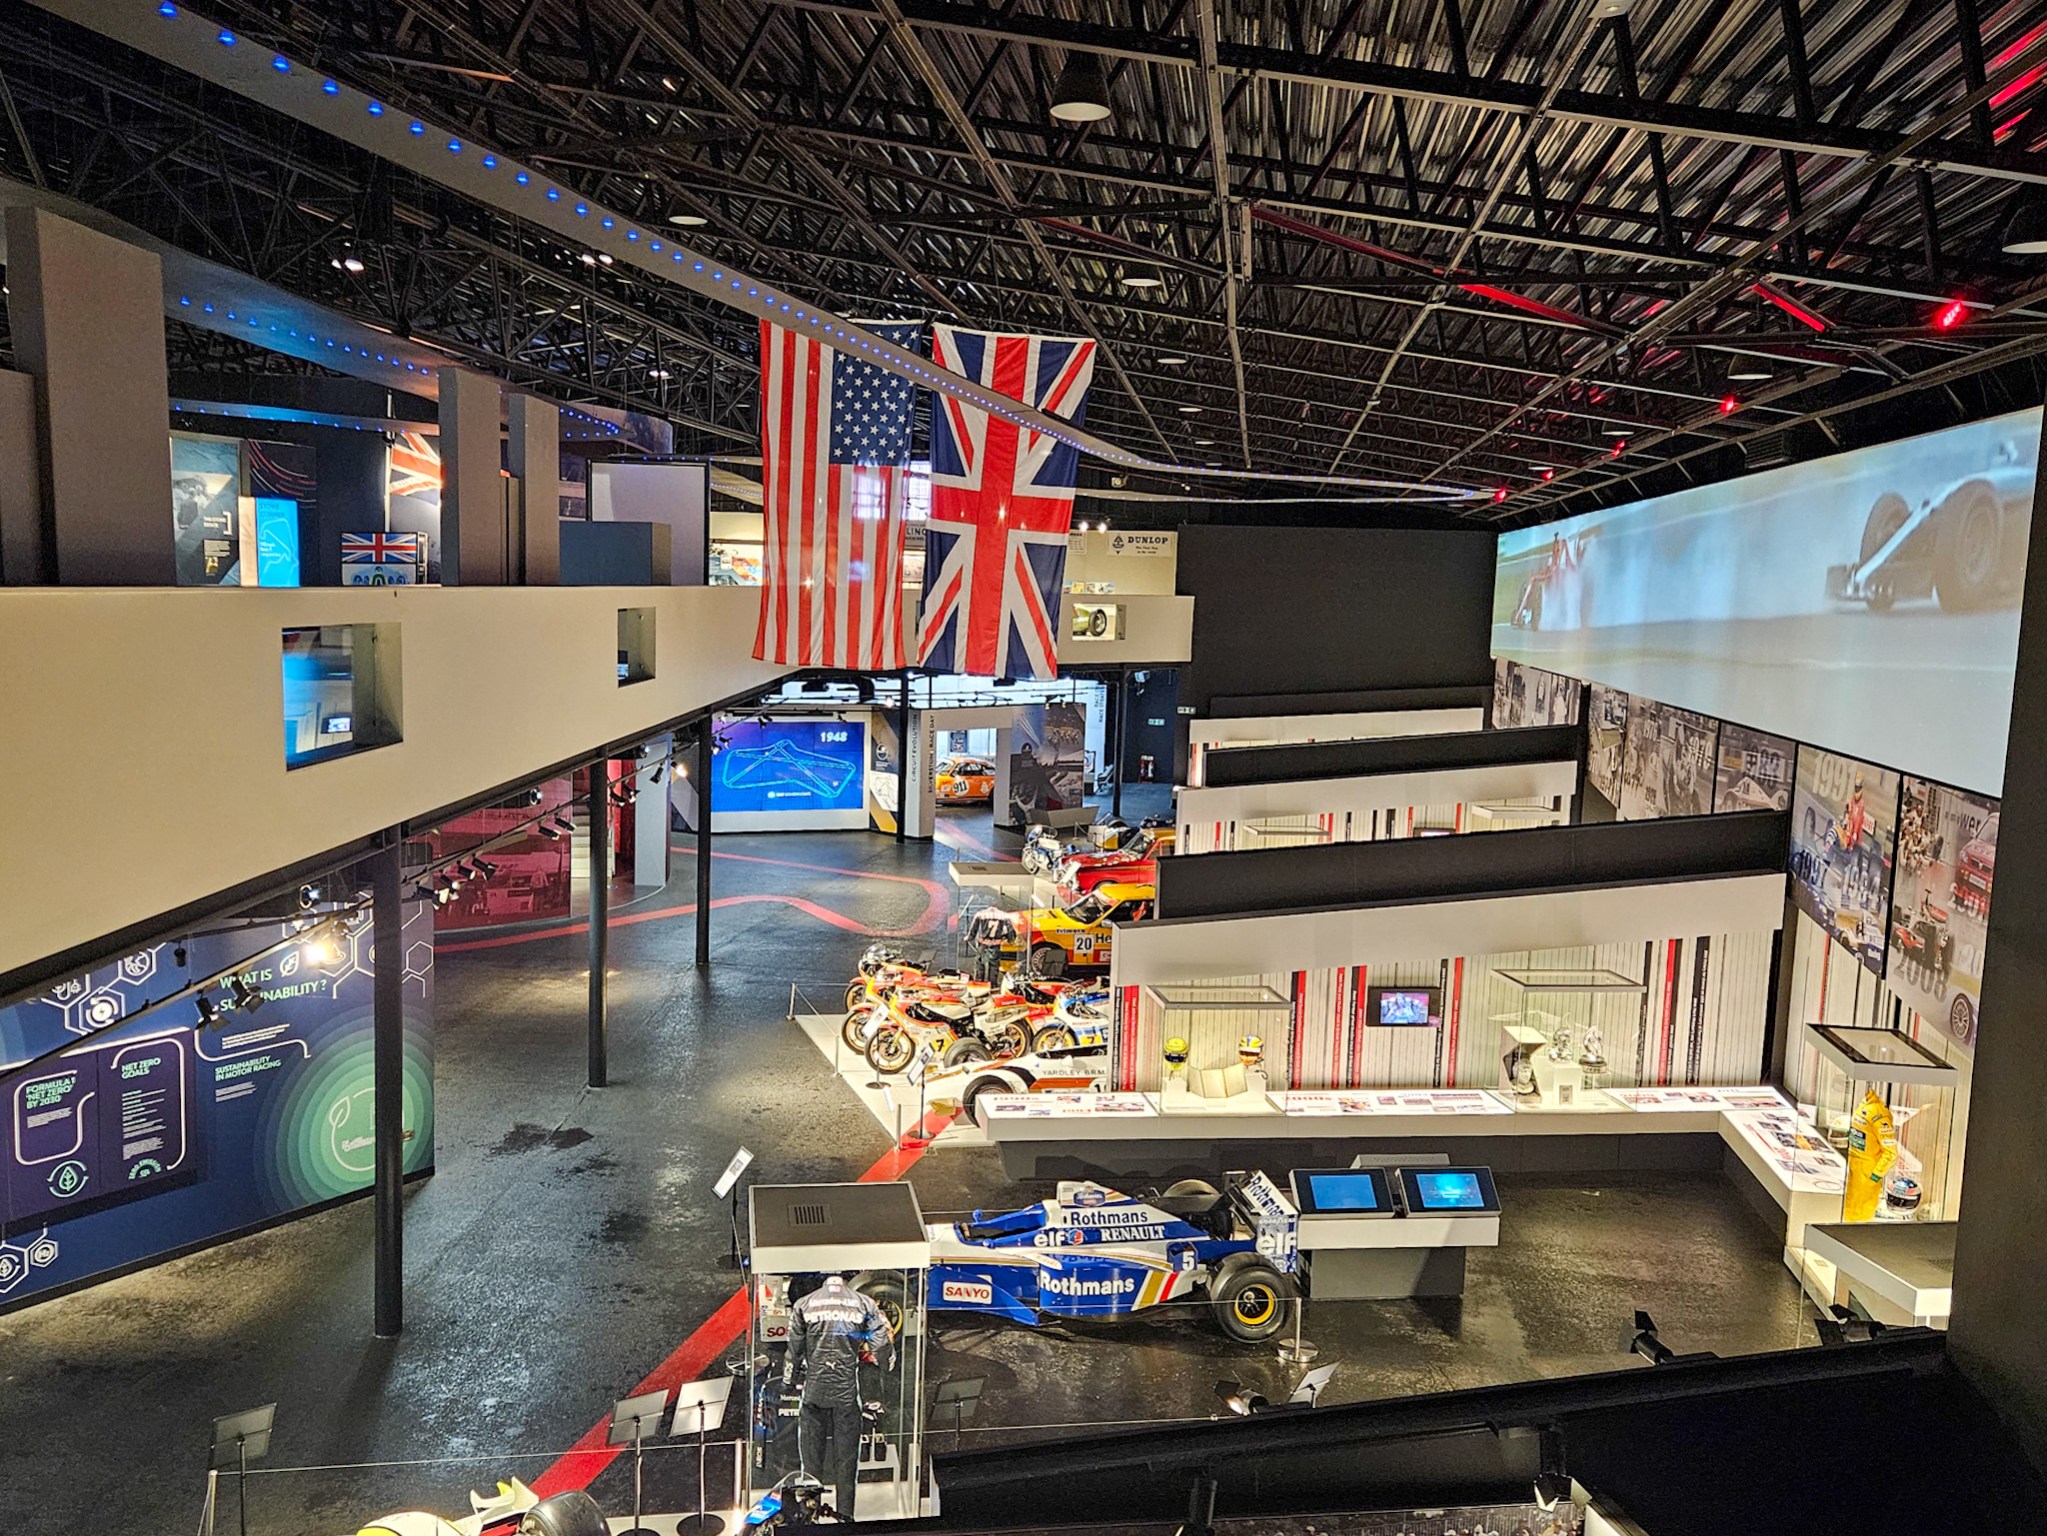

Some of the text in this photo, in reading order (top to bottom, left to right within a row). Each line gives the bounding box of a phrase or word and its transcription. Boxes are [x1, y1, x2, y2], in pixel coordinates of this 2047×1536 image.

[1128, 536, 1168, 545] DUNLOP
[820, 731, 848, 742] 1948
[953, 781, 968, 793] 911
[1812, 752, 1857, 806] 1991
[988, 920, 999, 938] 7
[1076, 938, 1092, 950] 20
[220, 969, 273, 989] WAT IS
[1894, 949, 1948, 1003] 2008
[220, 981, 319, 1012] SUNABILITY
[936, 1038, 945, 1052] 7
[121, 1057, 162, 1073] NET ZERO
[121, 1067, 151, 1080] GOALS
[215, 1055, 271, 1075] SUSTAINABILITY
[225, 1066, 253, 1080] MOTOR
[253, 1059, 282, 1073] RACING
[26, 1077, 71, 1095] FORMULA
[26, 1095, 62, 1110] BY 2030
[1247, 1175, 1286, 1217] Rothma
[1071, 1211, 1148, 1226] Rothmans
[1034, 1230, 1066, 1247] elf
[1100, 1225, 1166, 1242] RENAULT
[1256, 1233, 1297, 1256] elf
[1182, 1251, 1195, 1271] 5
[1039, 1269, 1135, 1297] Rothmans
[945, 1286, 990, 1299] SANYO
[803, 1310, 863, 1324] PETRONAS
[778, 1408, 799, 1416] PETR
